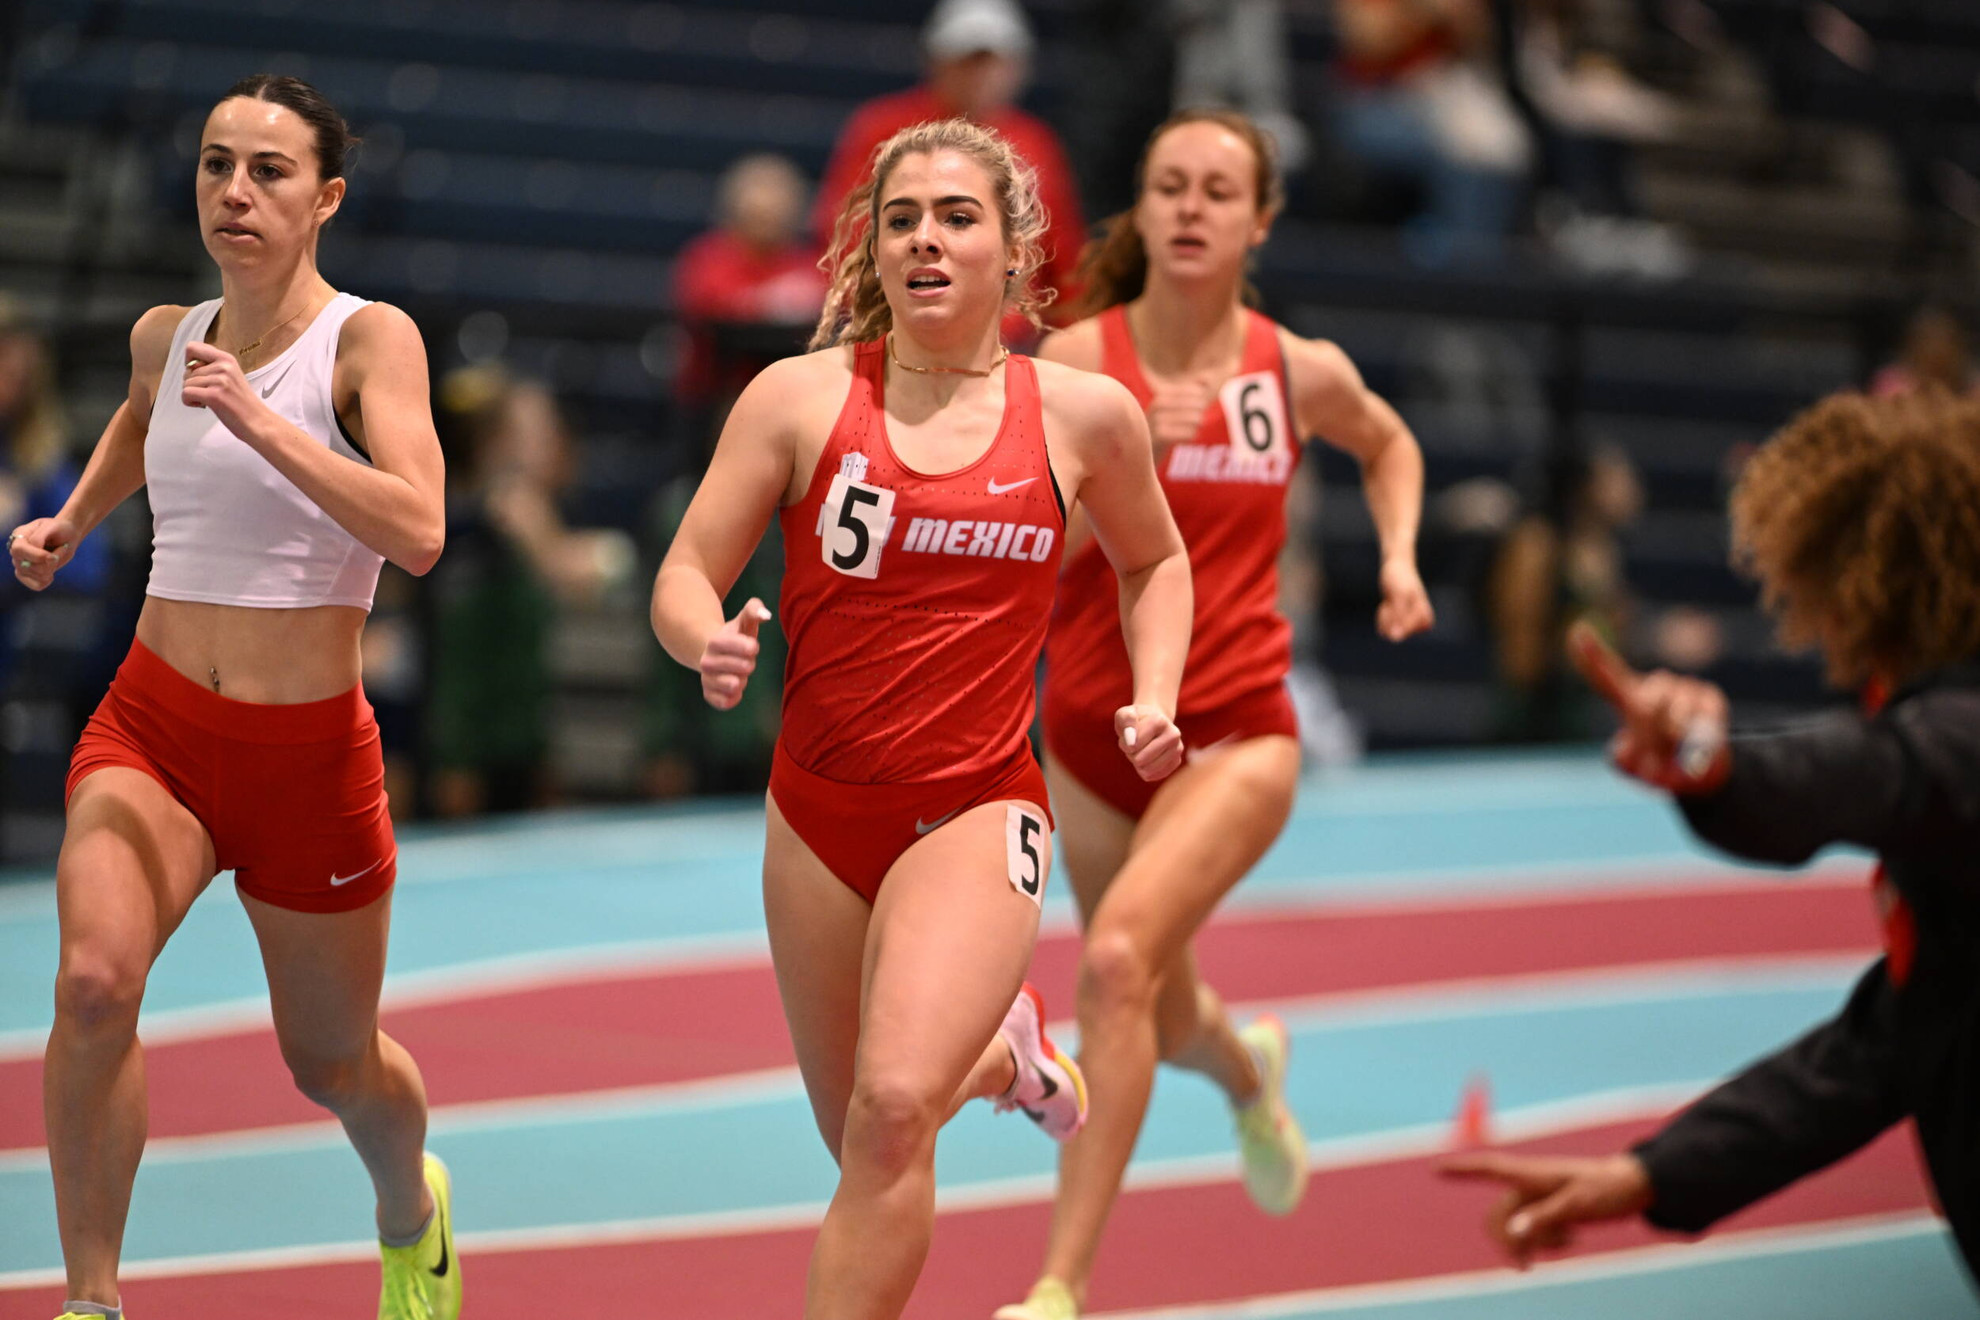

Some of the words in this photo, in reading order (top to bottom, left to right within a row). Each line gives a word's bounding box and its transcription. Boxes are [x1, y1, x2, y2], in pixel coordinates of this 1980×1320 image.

[1240, 382, 1272, 452] 6
[832, 485, 880, 570] 5
[902, 517, 1054, 562] MEXICO
[1020, 813, 1040, 896] 5
